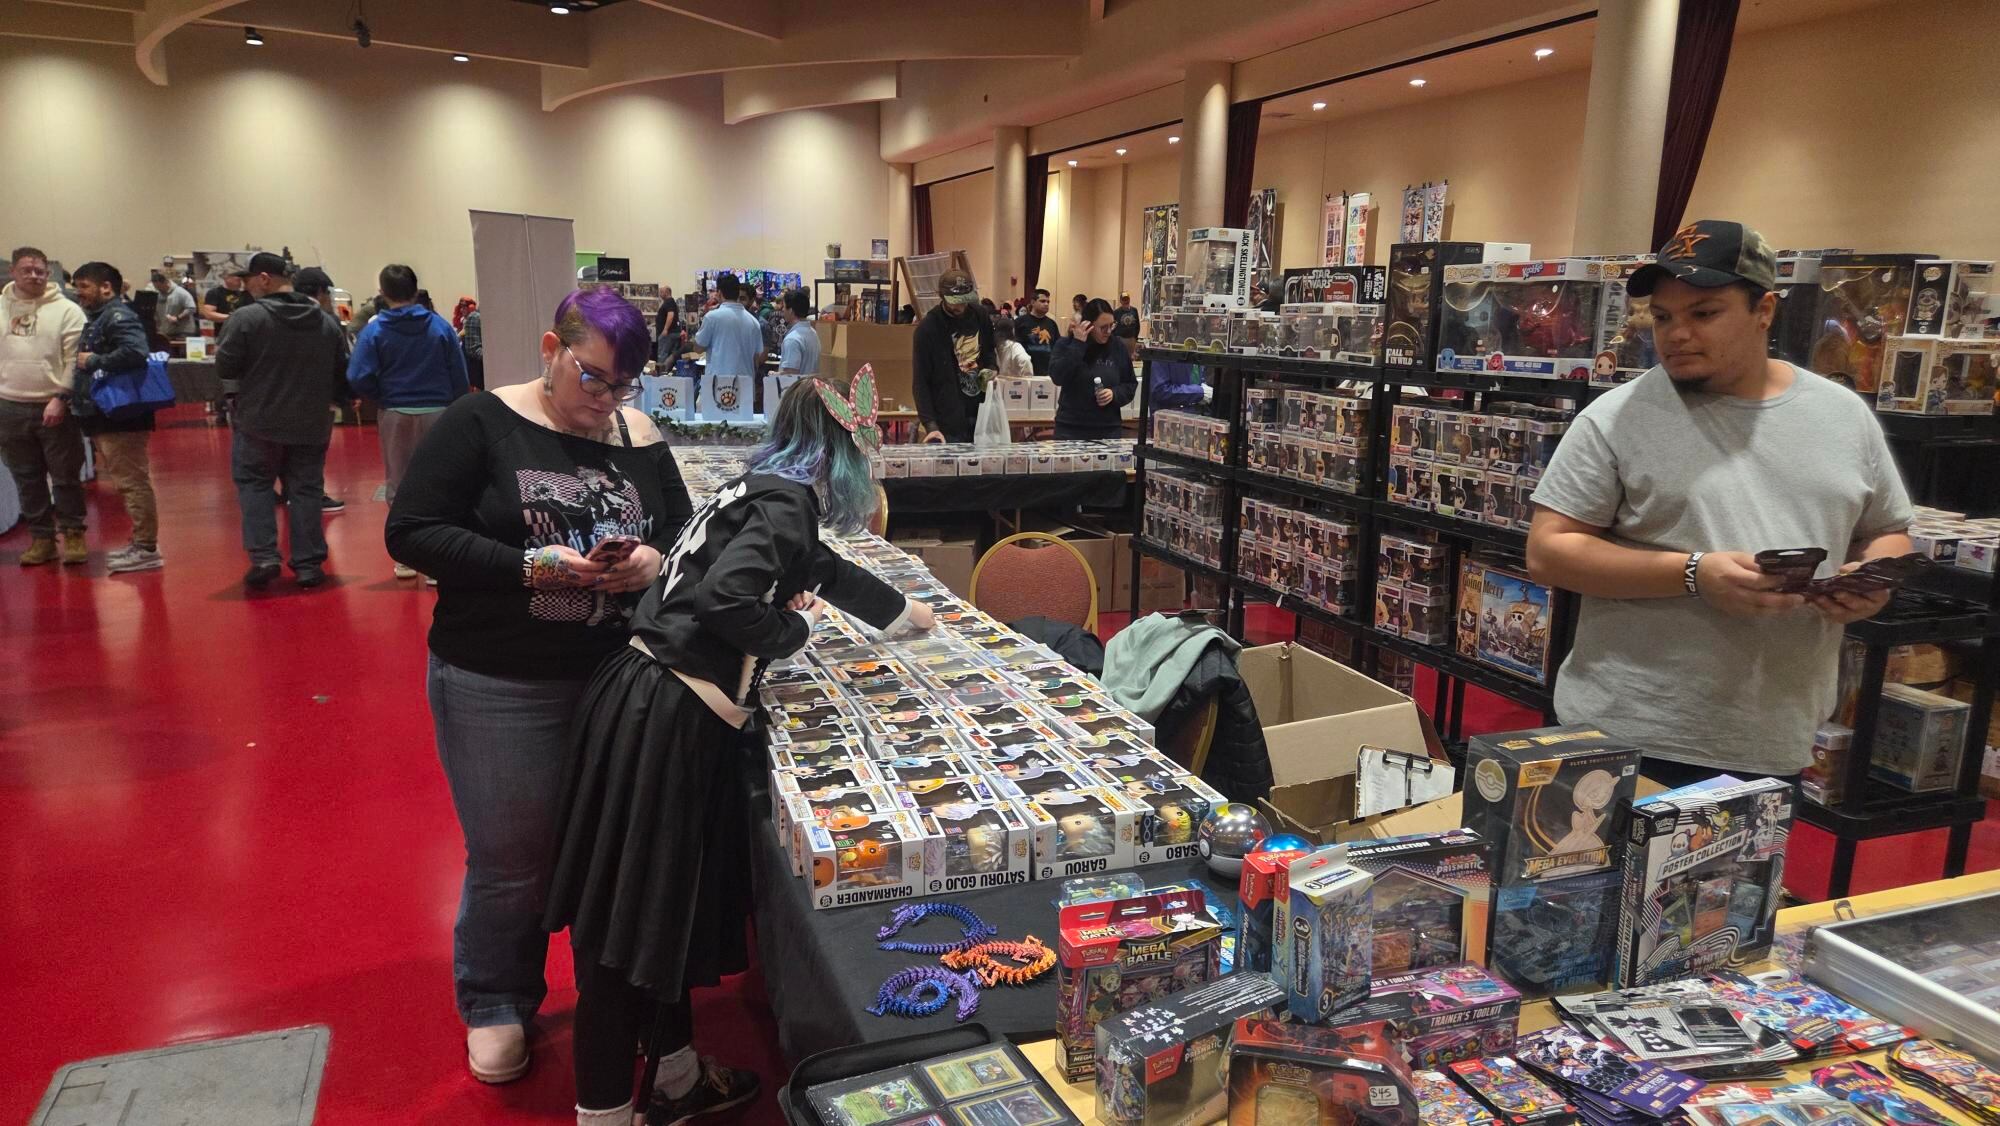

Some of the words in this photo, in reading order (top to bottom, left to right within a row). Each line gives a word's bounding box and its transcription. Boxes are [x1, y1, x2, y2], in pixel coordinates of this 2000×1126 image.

[1241, 231, 1249, 247] JACK
[1238, 248, 1249, 289] SKELLINGTON
[1311, 269, 1331, 279] STAR
[1308, 279, 1333, 289] WARS
[522, 554, 535, 578] VIP
[1684, 566, 1697, 593] VIP
[1166, 844, 1200, 860] SABO
[1347, 848, 1373, 858] OSTER
[1374, 841, 1431, 853] COLLECTION
[1662, 856, 1694, 875] POSTER
[1695, 834, 1743, 862] COLLECTION
[1065, 858, 1107, 876] GAROU
[1436, 862, 1485, 876] PRISMATIC
[1529, 855, 1556, 873] MEGA
[1557, 849, 1607, 867] EVOLUTION
[946, 875, 977, 891] GOJO
[981, 870, 1026, 887] SATORU
[836, 885, 913, 905] CHARMANDER
[1131, 942, 1167, 956] MEGA
[1126, 951, 1173, 967] BATTLE
[1694, 950, 1728, 967] WHITE
[1430, 1010, 1471, 1028] TRAINER'S
[1472, 1004, 1504, 1020] TOOLKIT
[1073, 1054, 1092, 1063] MEGA
[1370, 1087, 1392, 1099] $45
